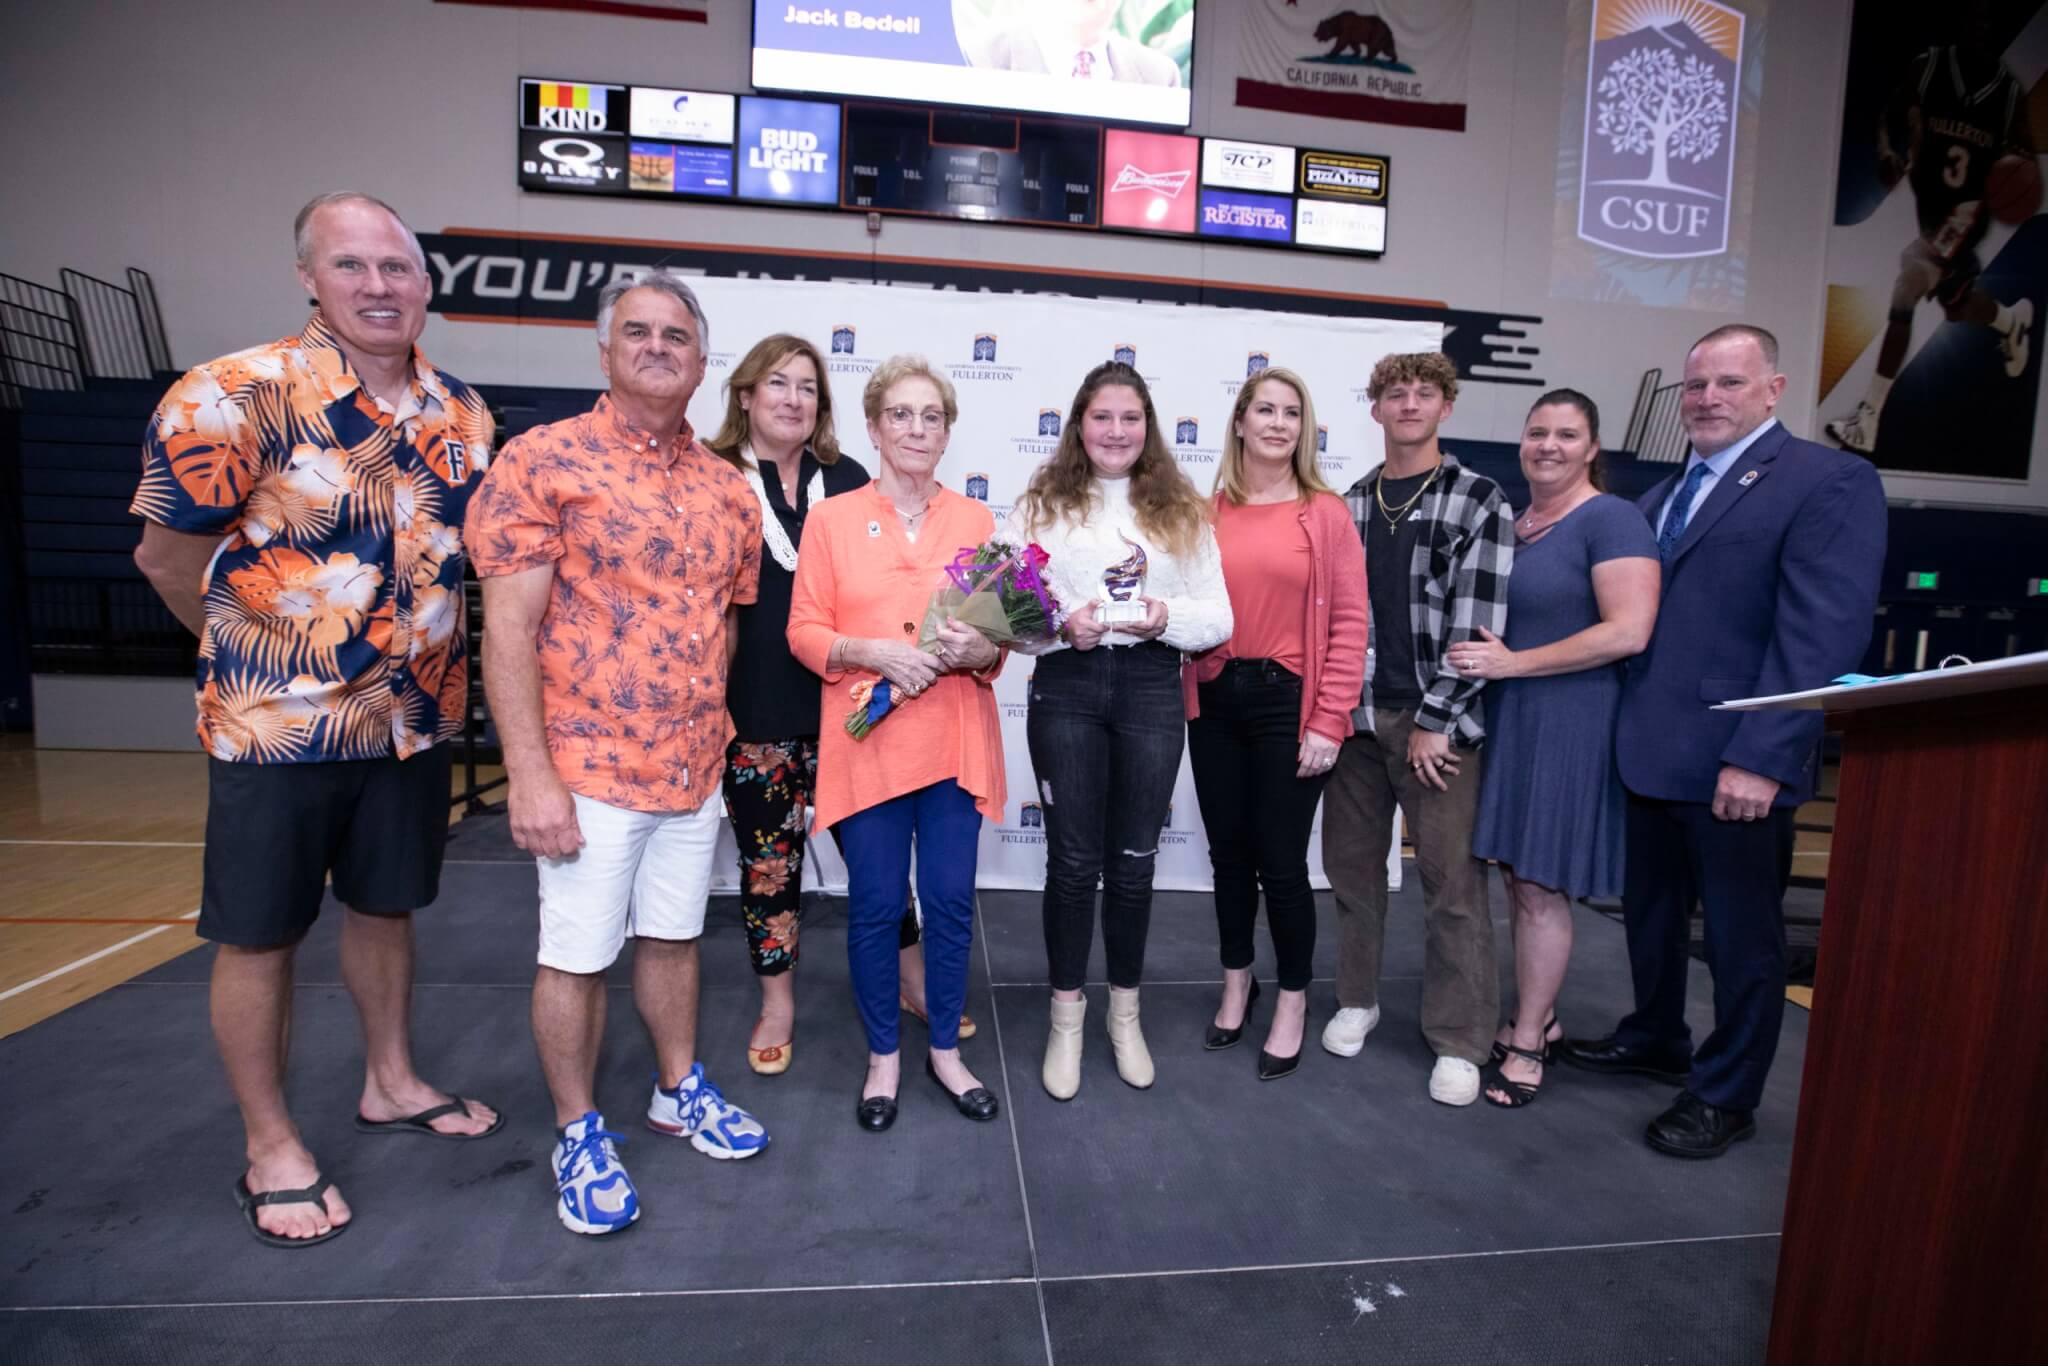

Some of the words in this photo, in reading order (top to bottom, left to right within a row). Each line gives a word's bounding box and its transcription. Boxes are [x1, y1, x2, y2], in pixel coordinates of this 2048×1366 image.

[784, 5, 838, 27] Jack
[844, 10, 920, 34] Bedell
[1287, 67, 1358, 87] CALIFORNIA
[1367, 75, 1422, 97] REPUBLIC
[539, 107, 607, 131] KIND
[761, 128, 817, 151] BUD
[750, 148, 828, 173] LIGHT
[950, 156, 977, 166] PERIOD
[1943, 144, 1970, 188] 3
[853, 165, 878, 176] FOULS
[1307, 168, 1343, 183] PIZZA
[1344, 171, 1379, 189] PRESS
[946, 173, 973, 183] PLAYER
[980, 176, 999, 186] FOUL
[1066, 183, 1089, 193] FOULS
[1119, 171, 1186, 188] Budweiser
[857, 196, 872, 206] SET
[1069, 213, 1083, 223] SET
[1204, 207, 1288, 230] REGISTER
[1601, 196, 1710, 237] CSUF
[829, 363, 873, 374] LERTON
[952, 370, 1014, 380] FULLERTON
[1176, 453, 1214, 463] LERTON
